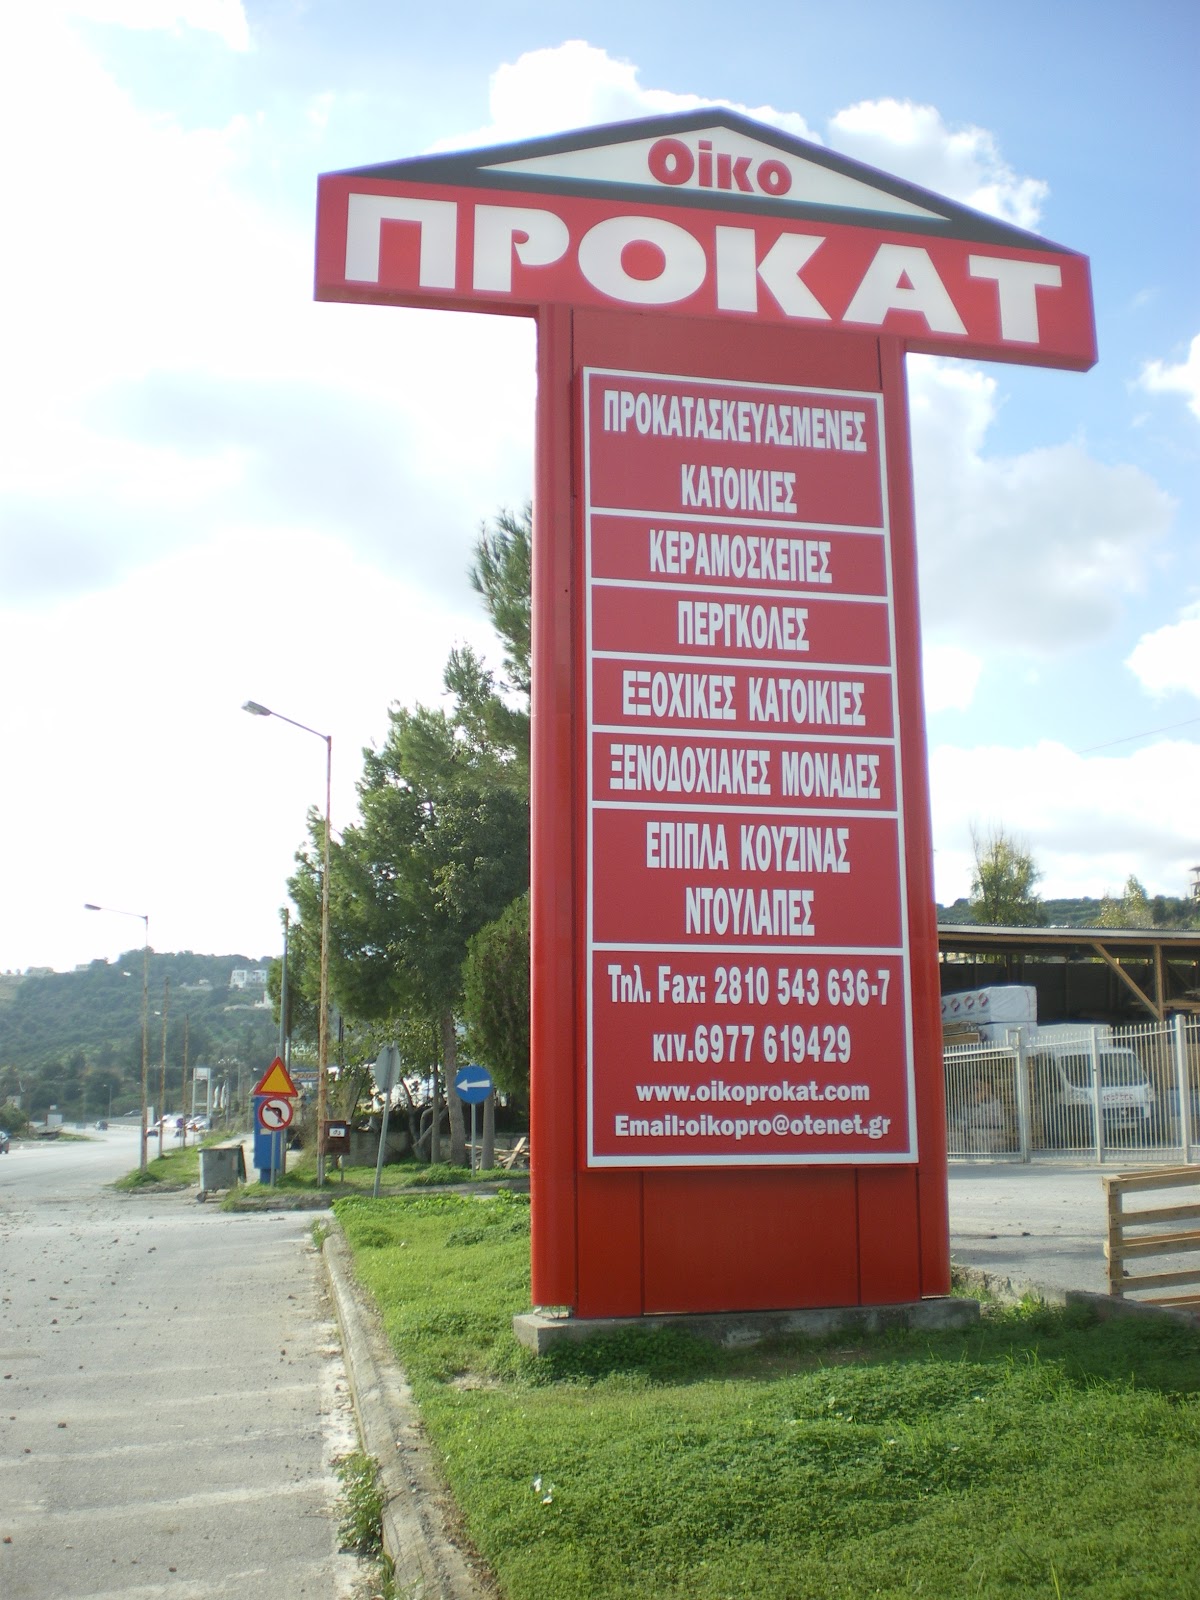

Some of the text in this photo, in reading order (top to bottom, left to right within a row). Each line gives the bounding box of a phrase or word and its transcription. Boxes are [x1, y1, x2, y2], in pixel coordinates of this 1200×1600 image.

[345, 193, 1062, 343] ΠΡΟΚΑΤ
[604, 390, 867, 452] ΠΡΟΚΑΤΑΣΚΕΥΑΣΜΕΝΕΣ
[681, 464, 797, 513] ΚΑΤΟΙΚΙΕΣ
[650, 529, 832, 583] ΚΕΡΑΜΟΣΚΕΠΕΣ
[678, 601, 809, 651] ΠΕΡΓΚΟΛΕΣ
[623, 670, 866, 726] ΕΞΟΧΙΚΕΣ ΚΑΤΟΙΚΙΕΣ
[610, 743, 881, 799] ΞΕΝΟΔΟΧΙΑΚΕΣ ΜΟΝΑΔΕΣ
[646, 822, 850, 873] ΕΠΙΠΛΑ ΚΟΥΖΙΝΑΣ
[685, 887, 814, 936] ΝΤΟΥΛΑΠΕΣ
[608, 965, 890, 1006] Τηλ. Fax: 2810 543 636-7
[764, 1025, 850, 1063] 619429
[636, 1081, 870, 1105] www.oikoprokat.com
[615, 1115, 891, 1140] Email:oikopro@otenet.gr
